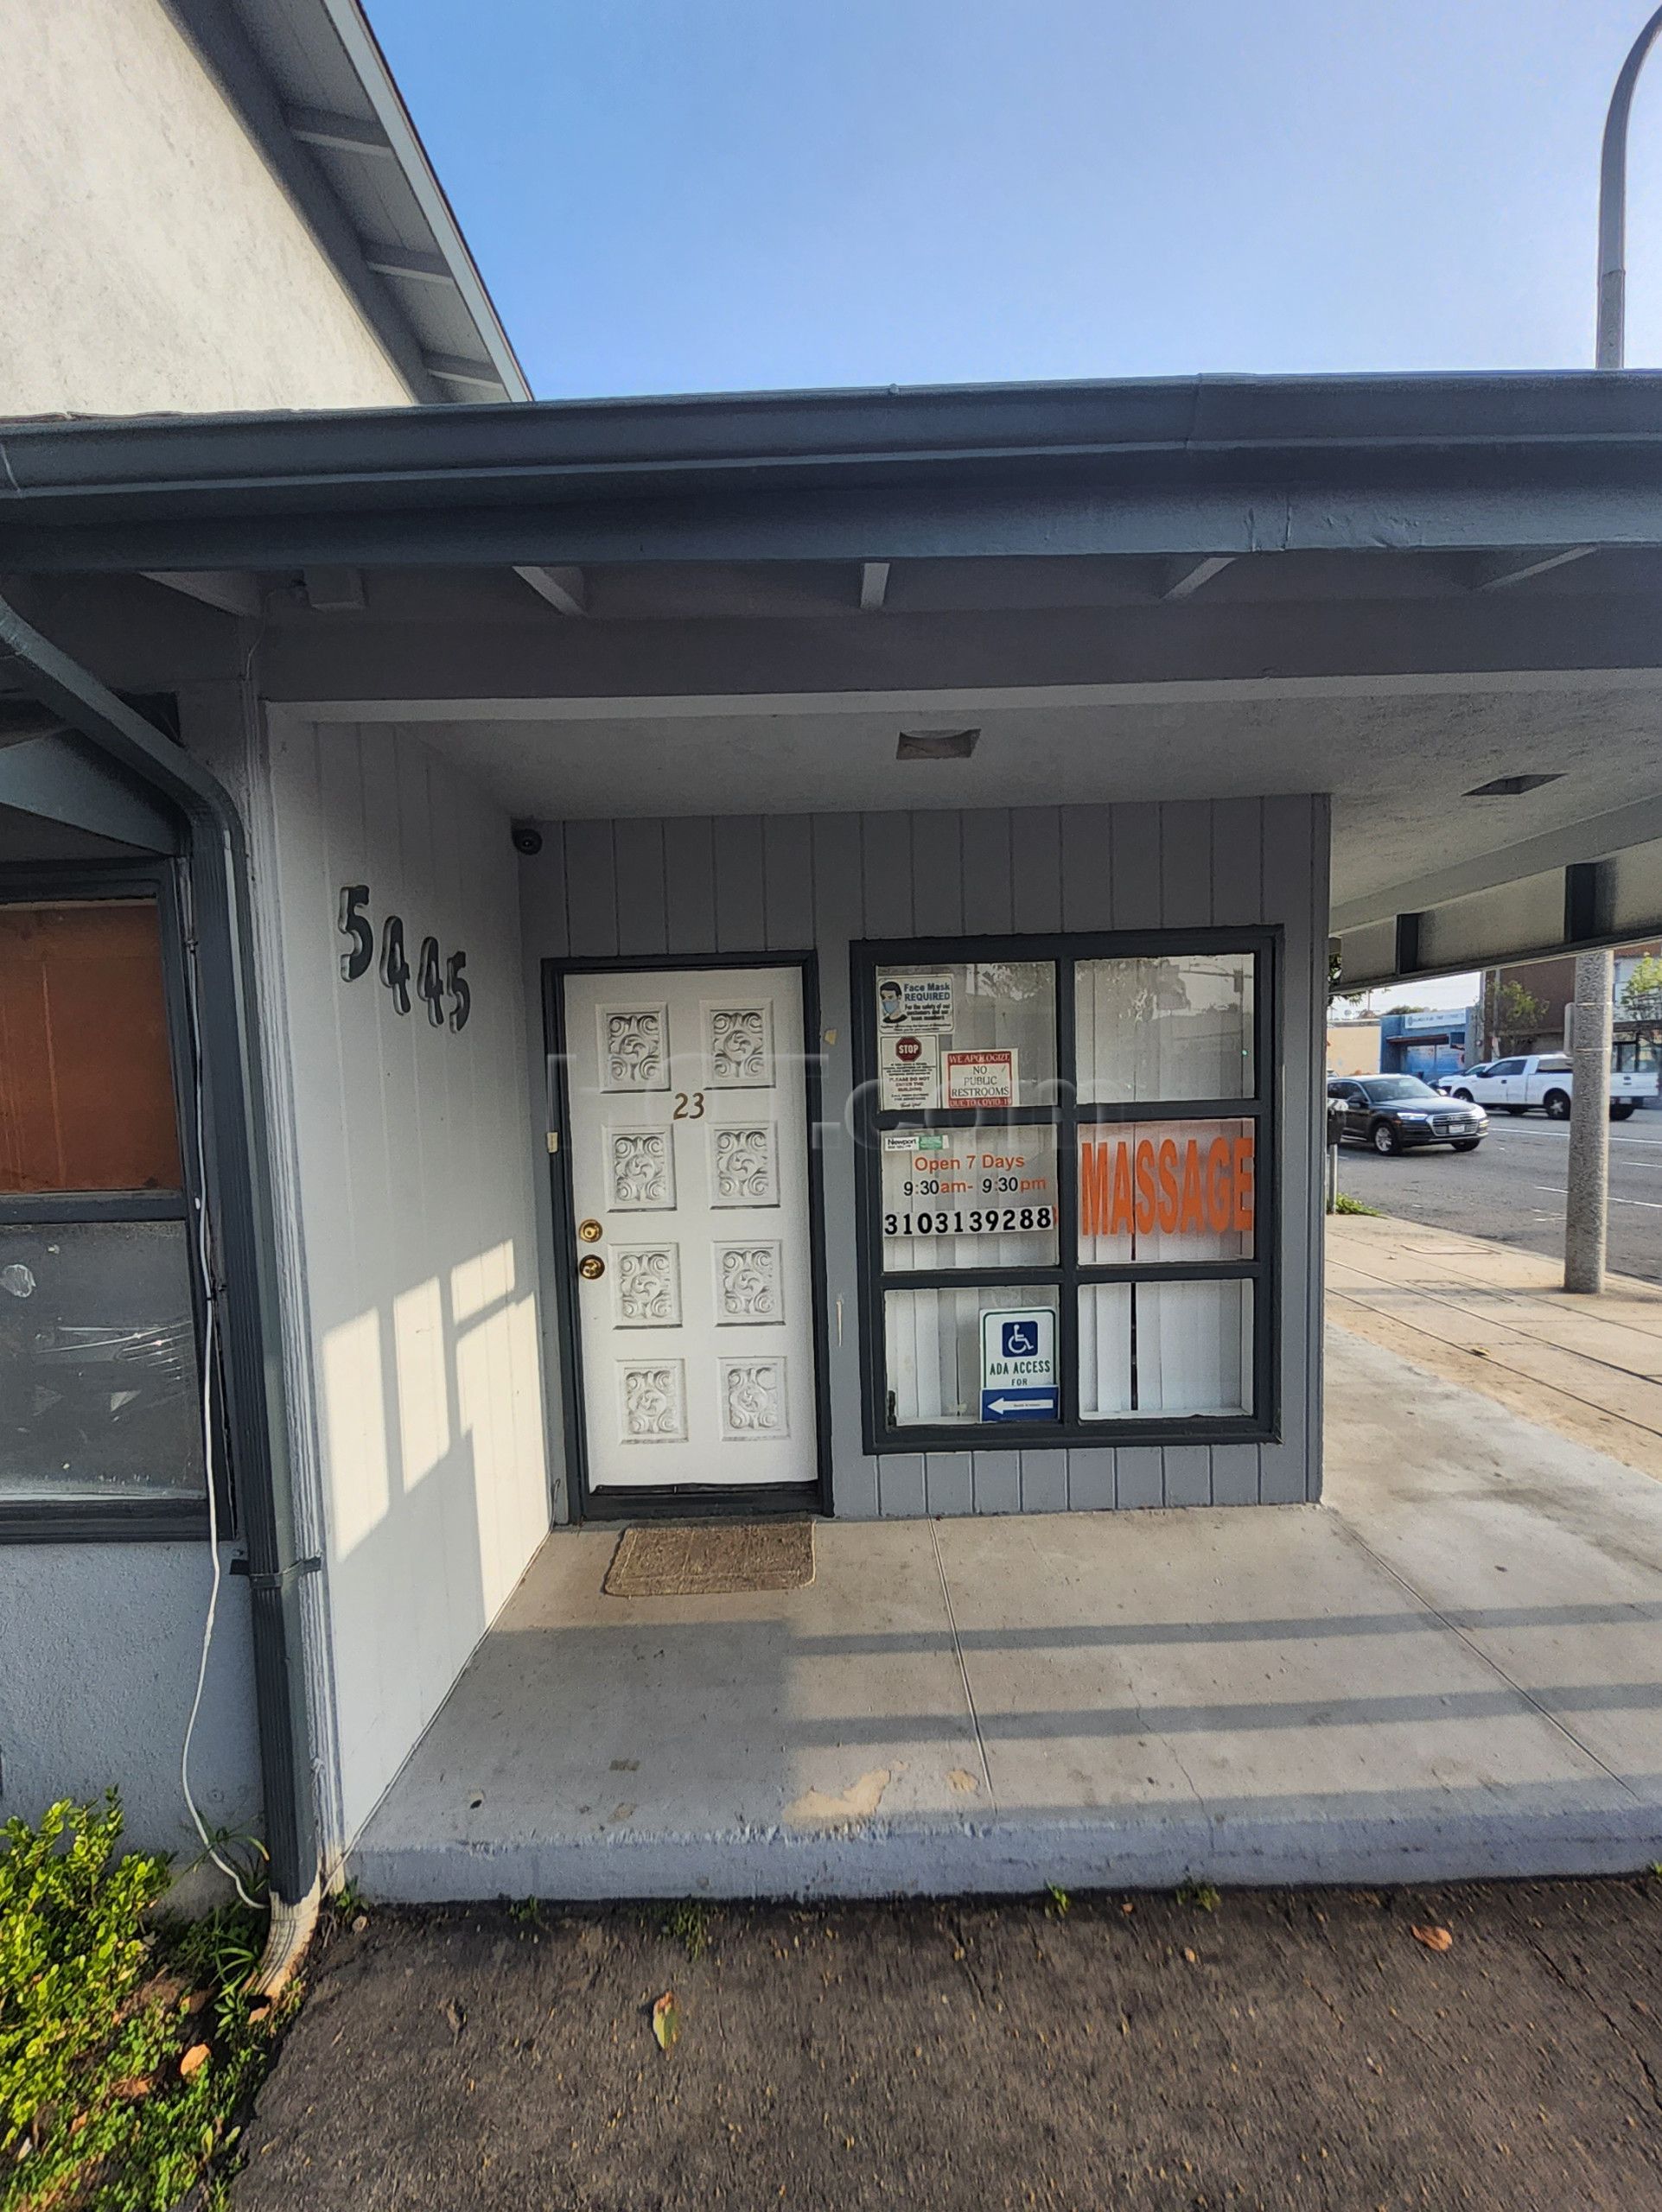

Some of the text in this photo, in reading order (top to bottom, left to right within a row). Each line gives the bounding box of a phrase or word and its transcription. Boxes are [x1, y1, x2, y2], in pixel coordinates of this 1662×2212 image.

[338, 885, 470, 1033] 5445
[904, 982, 950, 992] Face Mask
[904, 992, 951, 1001] REQUIRED
[899, 1045, 919, 1054] STOP
[949, 1053, 1010, 1064] WE APOLOGIZE
[973, 1065, 987, 1075] NO
[964, 1076, 997, 1086] PUBLIC
[952, 1087, 1009, 1096] RESTROOMS
[673, 1092, 704, 1120] 23
[977, 1097, 1011, 1106] COVID-19
[914, 1154, 1024, 1173] Open 7 Days
[982, 1177, 1046, 1192] 9:30pm
[1082, 1137, 1252, 1236] MASSAGE
[884, 1208, 1051, 1235] 3103139288
[990, 1360, 1050, 1375] ADA ACCESS
